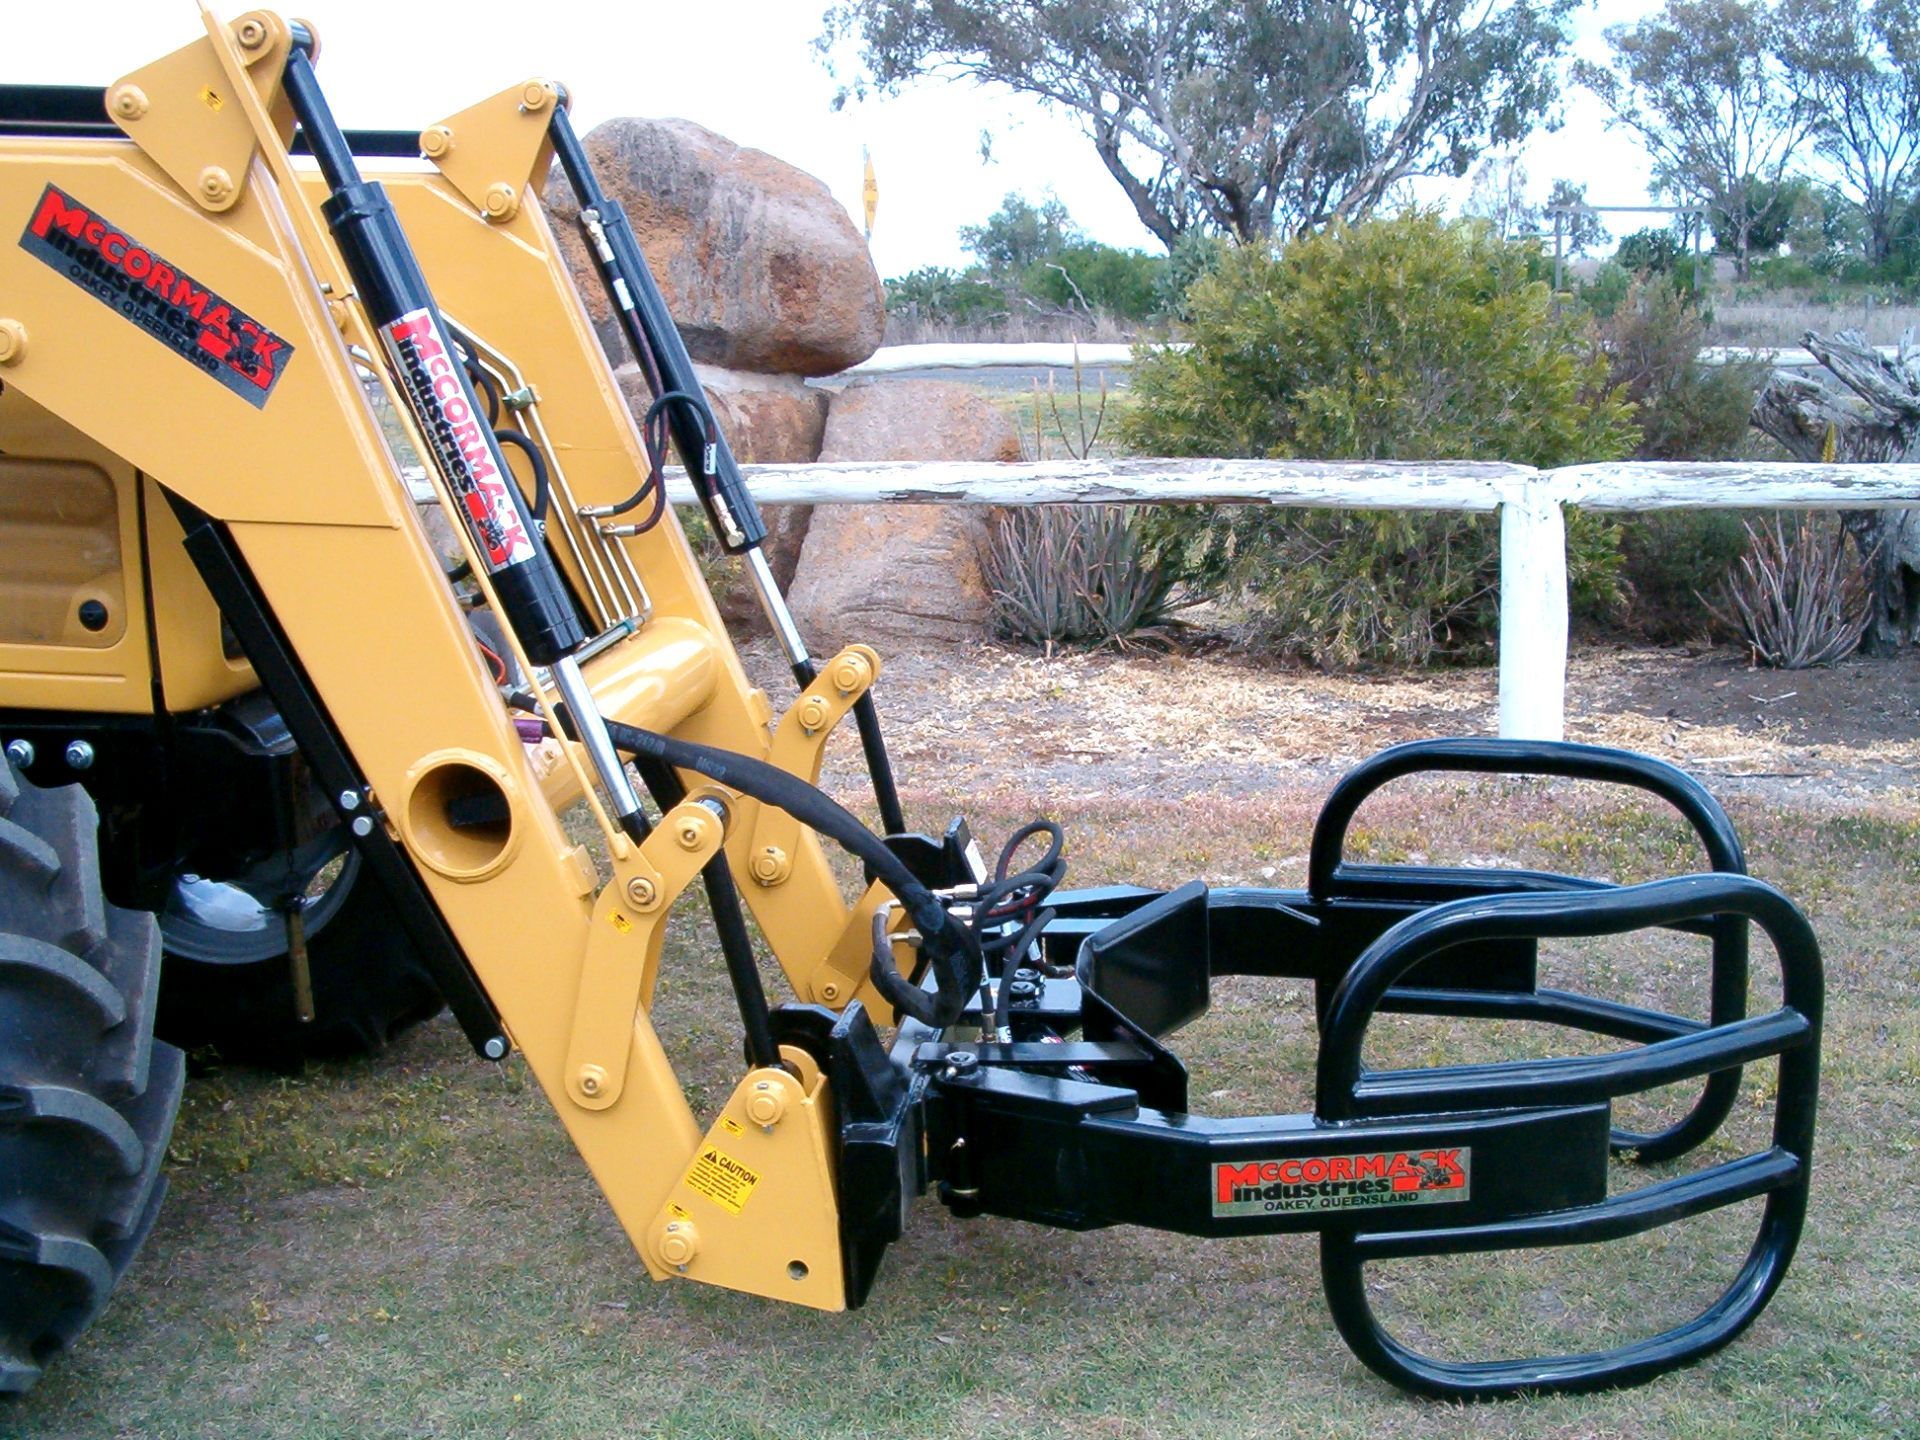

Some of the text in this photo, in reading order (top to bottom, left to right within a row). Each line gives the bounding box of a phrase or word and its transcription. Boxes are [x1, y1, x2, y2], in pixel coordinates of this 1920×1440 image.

[122, 300, 219, 372] QUEENSLAND
[397, 338, 474, 493] industries
[718, 1156, 758, 1186] CAUTION
[1233, 1177, 1390, 1202] industries
[1320, 1191, 1419, 1209] QUEENSLAND
